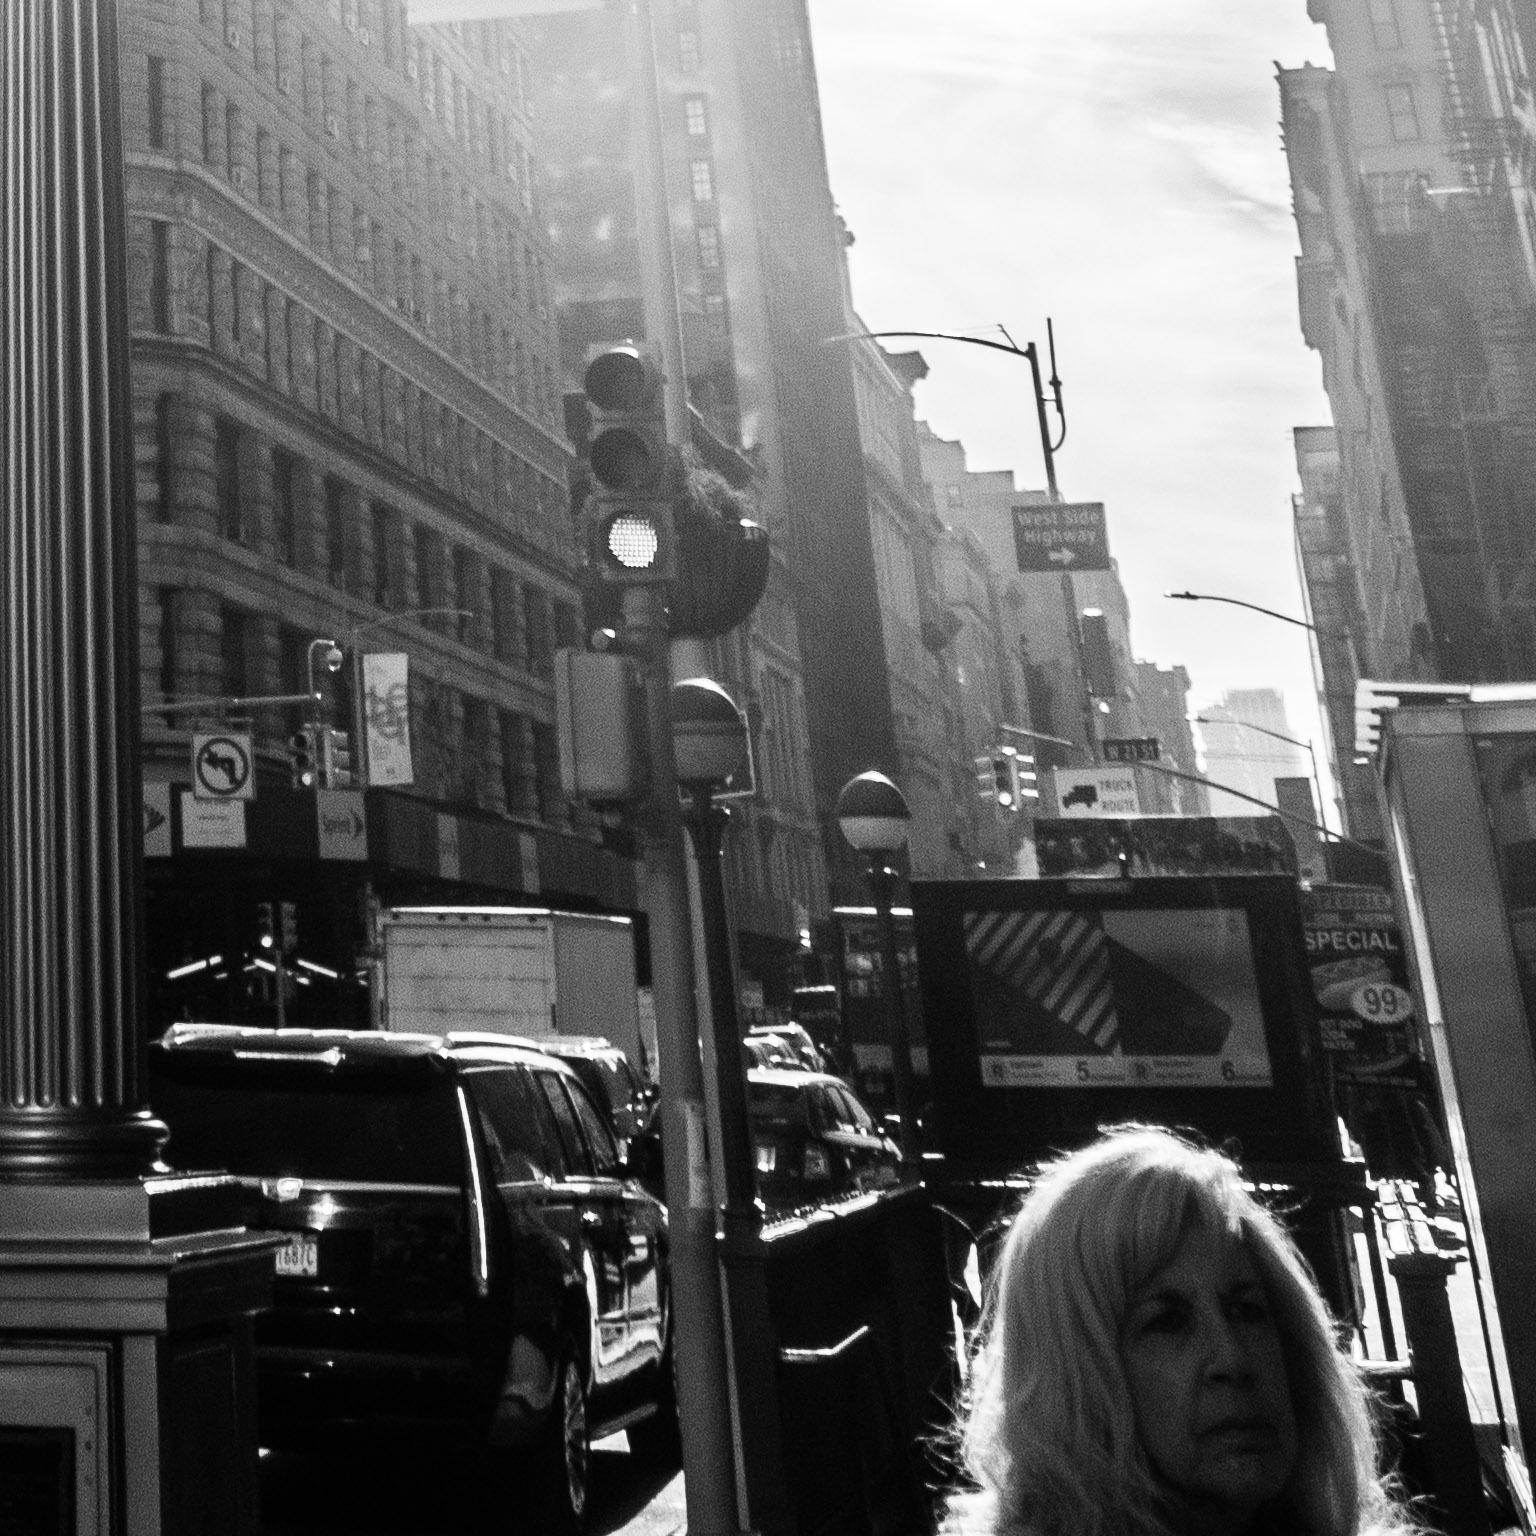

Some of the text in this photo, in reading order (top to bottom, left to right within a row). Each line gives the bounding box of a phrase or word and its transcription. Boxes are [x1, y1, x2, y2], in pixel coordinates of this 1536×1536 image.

[1018, 509, 1100, 526] West Side
[1023, 528, 1096, 547] Highway
[1098, 779, 1132, 792] TRUCK
[1102, 799, 1136, 812] ROUTE
[1305, 930, 1399, 951] SPECIAL
[1076, 1061, 1090, 1082] 5
[1221, 1060, 1235, 1082] 6
